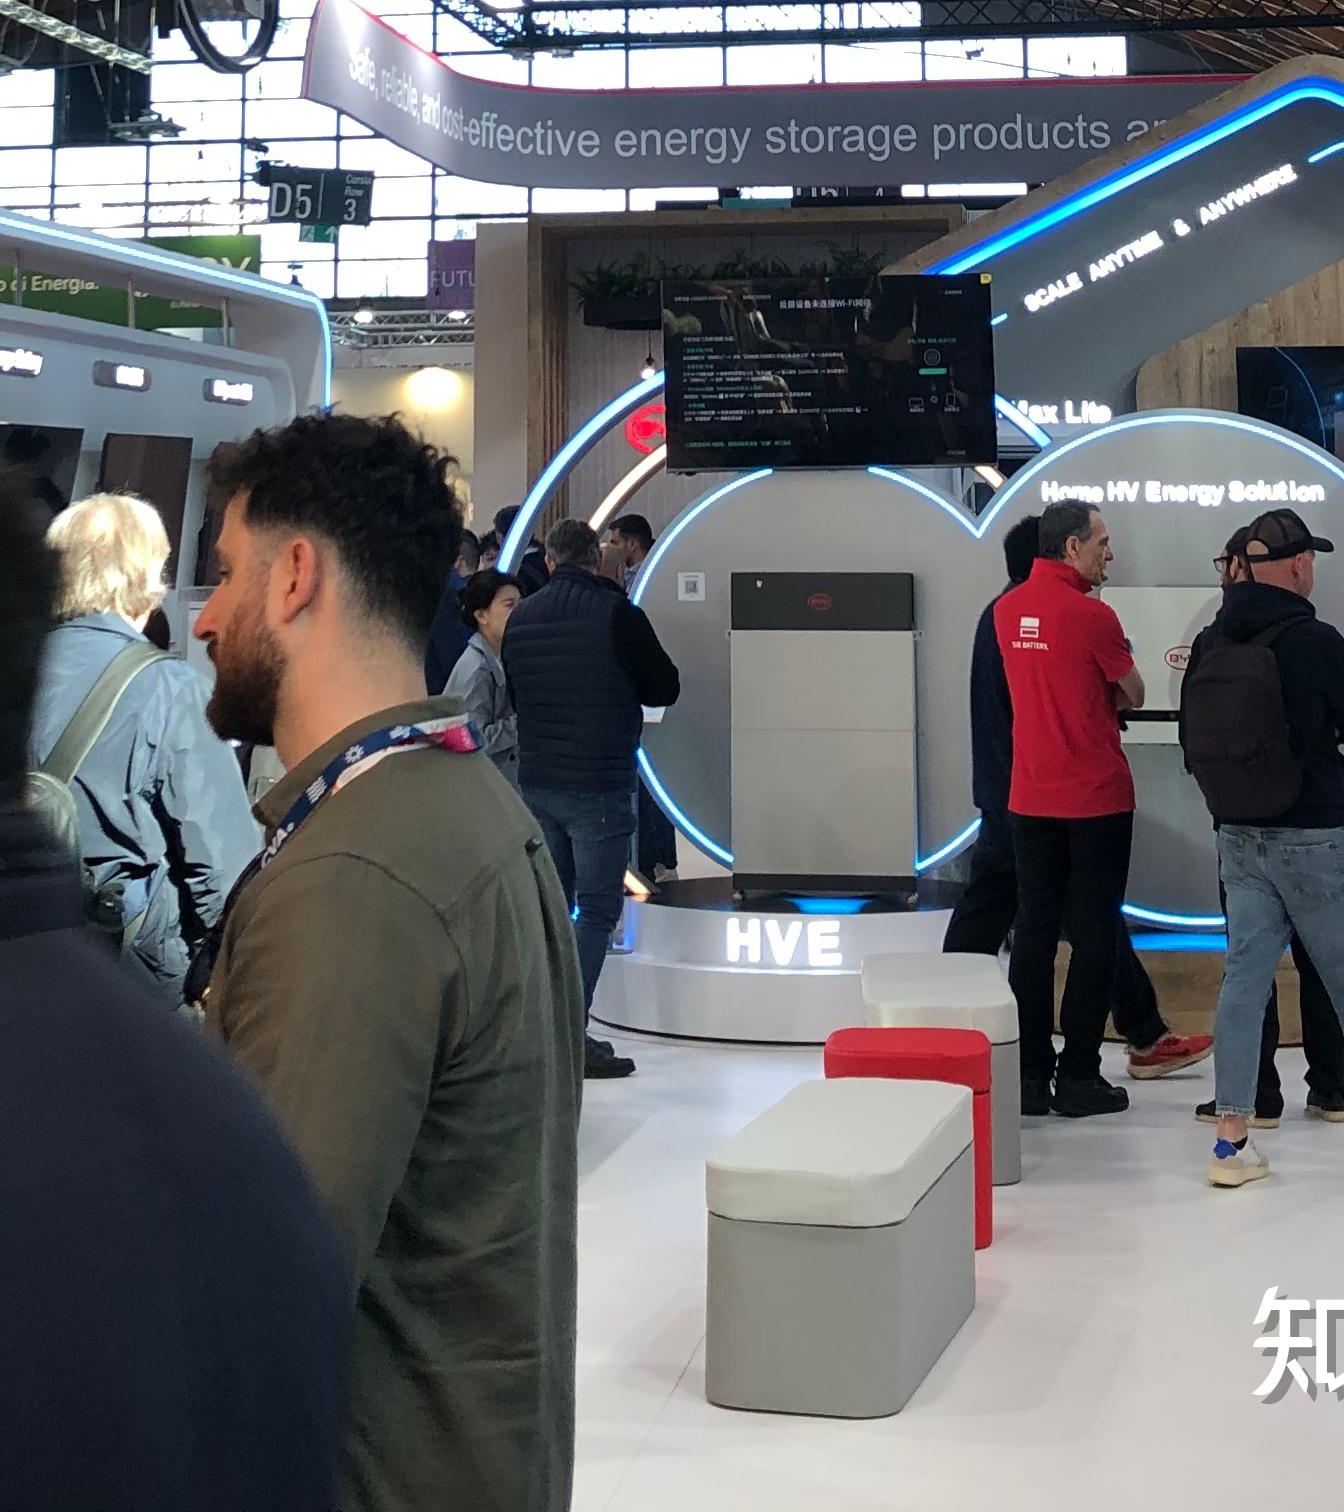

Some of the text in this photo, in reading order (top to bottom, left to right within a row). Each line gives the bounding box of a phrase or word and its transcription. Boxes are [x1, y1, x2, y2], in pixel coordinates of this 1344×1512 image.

[381, 66, 421, 125] reliable,
[422, 91, 441, 130] and
[442, 104, 600, 157] cost-effective
[614, 124, 752, 165] energy
[765, 118, 918, 162] storage
[933, 113, 1112, 160] products
[270, 182, 357, 221] D5 3
[1023, 163, 1299, 313] SCALE ANYTIME & ANYWHERE
[1065, 400, 1112, 425] Lite
[1041, 480, 1325, 507] Home HV Energy Solution
[1170, 653, 1191, 663] BY
[726, 917, 843, 967] HVE
